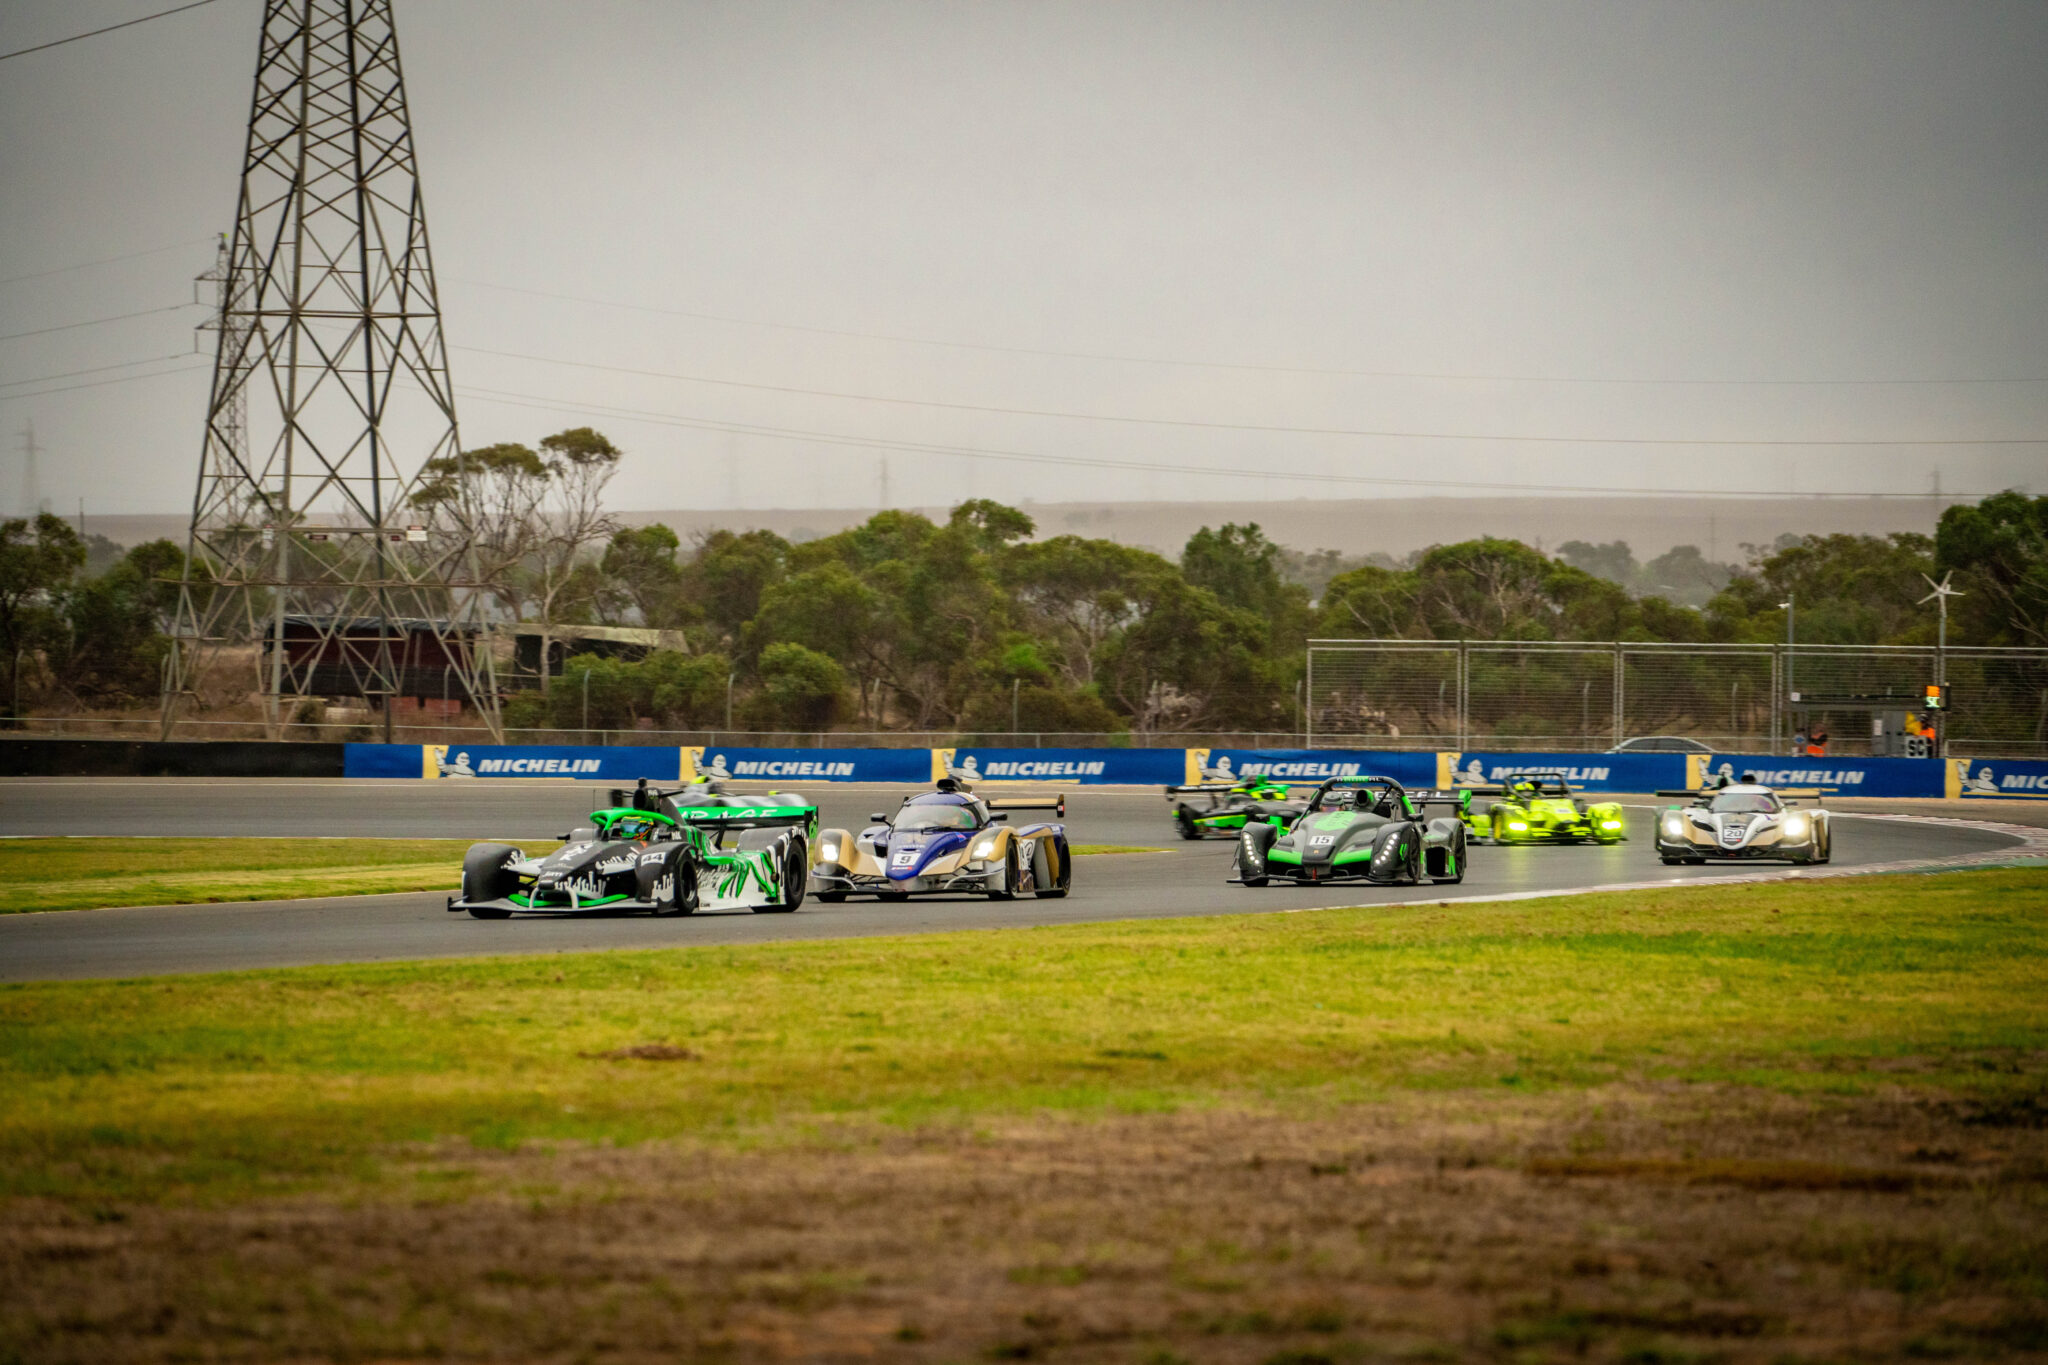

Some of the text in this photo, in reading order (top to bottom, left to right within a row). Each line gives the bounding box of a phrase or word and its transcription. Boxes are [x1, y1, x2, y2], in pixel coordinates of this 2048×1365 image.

[1908, 739, 1925, 756] SC
[477, 758, 602, 774] MICHELIN
[733, 761, 855, 776] MICHELIN
[984, 761, 1106, 776] MICHELIN
[1238, 762, 1361, 777] MICHELIN
[1490, 766, 1610, 781] MICHELIN
[1313, 836, 1332, 845] 15
[642, 853, 663, 862] 44
[899, 855, 912, 864] 9
